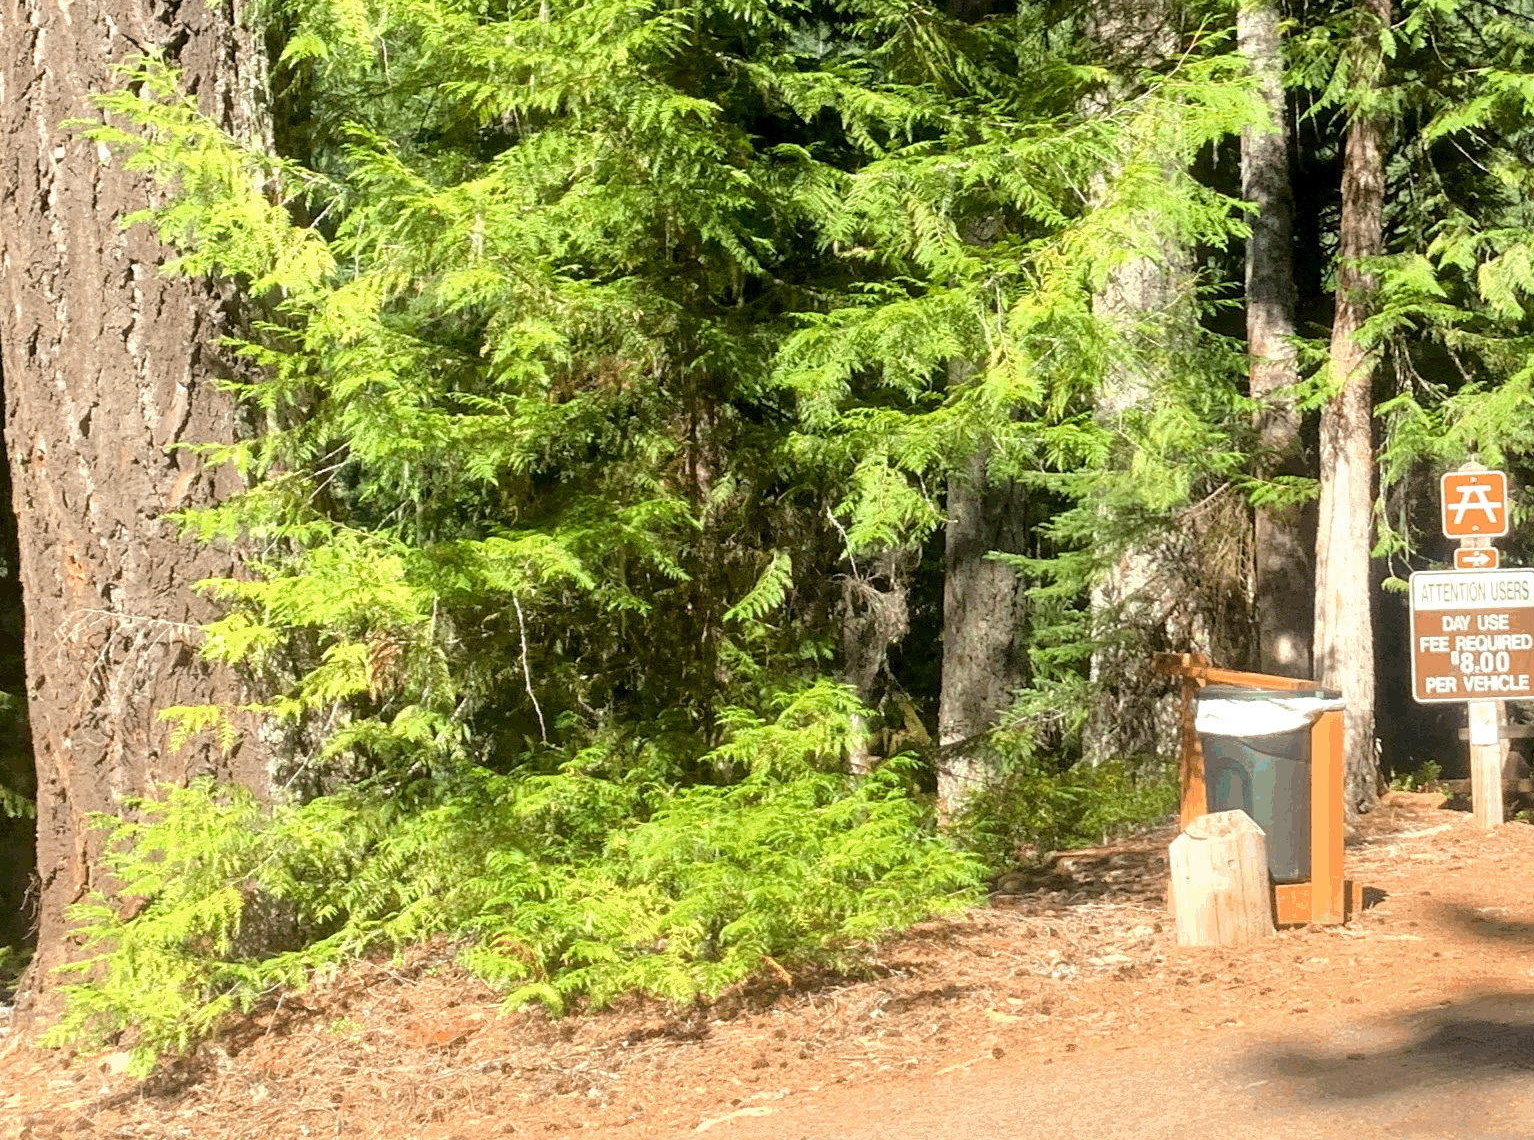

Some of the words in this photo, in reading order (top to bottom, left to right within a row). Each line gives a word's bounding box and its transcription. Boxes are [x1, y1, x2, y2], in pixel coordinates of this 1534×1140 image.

[1421, 583, 1486, 602] ATTENTION
[1491, 580, 1529, 600] USERS
[1442, 616, 1470, 631] DAY
[1477, 614, 1509, 630] USE
[1420, 637, 1449, 652] FEE
[1456, 634, 1533, 651] REQUIRED
[1426, 677, 1456, 693] PER
[1463, 675, 1529, 692] VEHICLE
